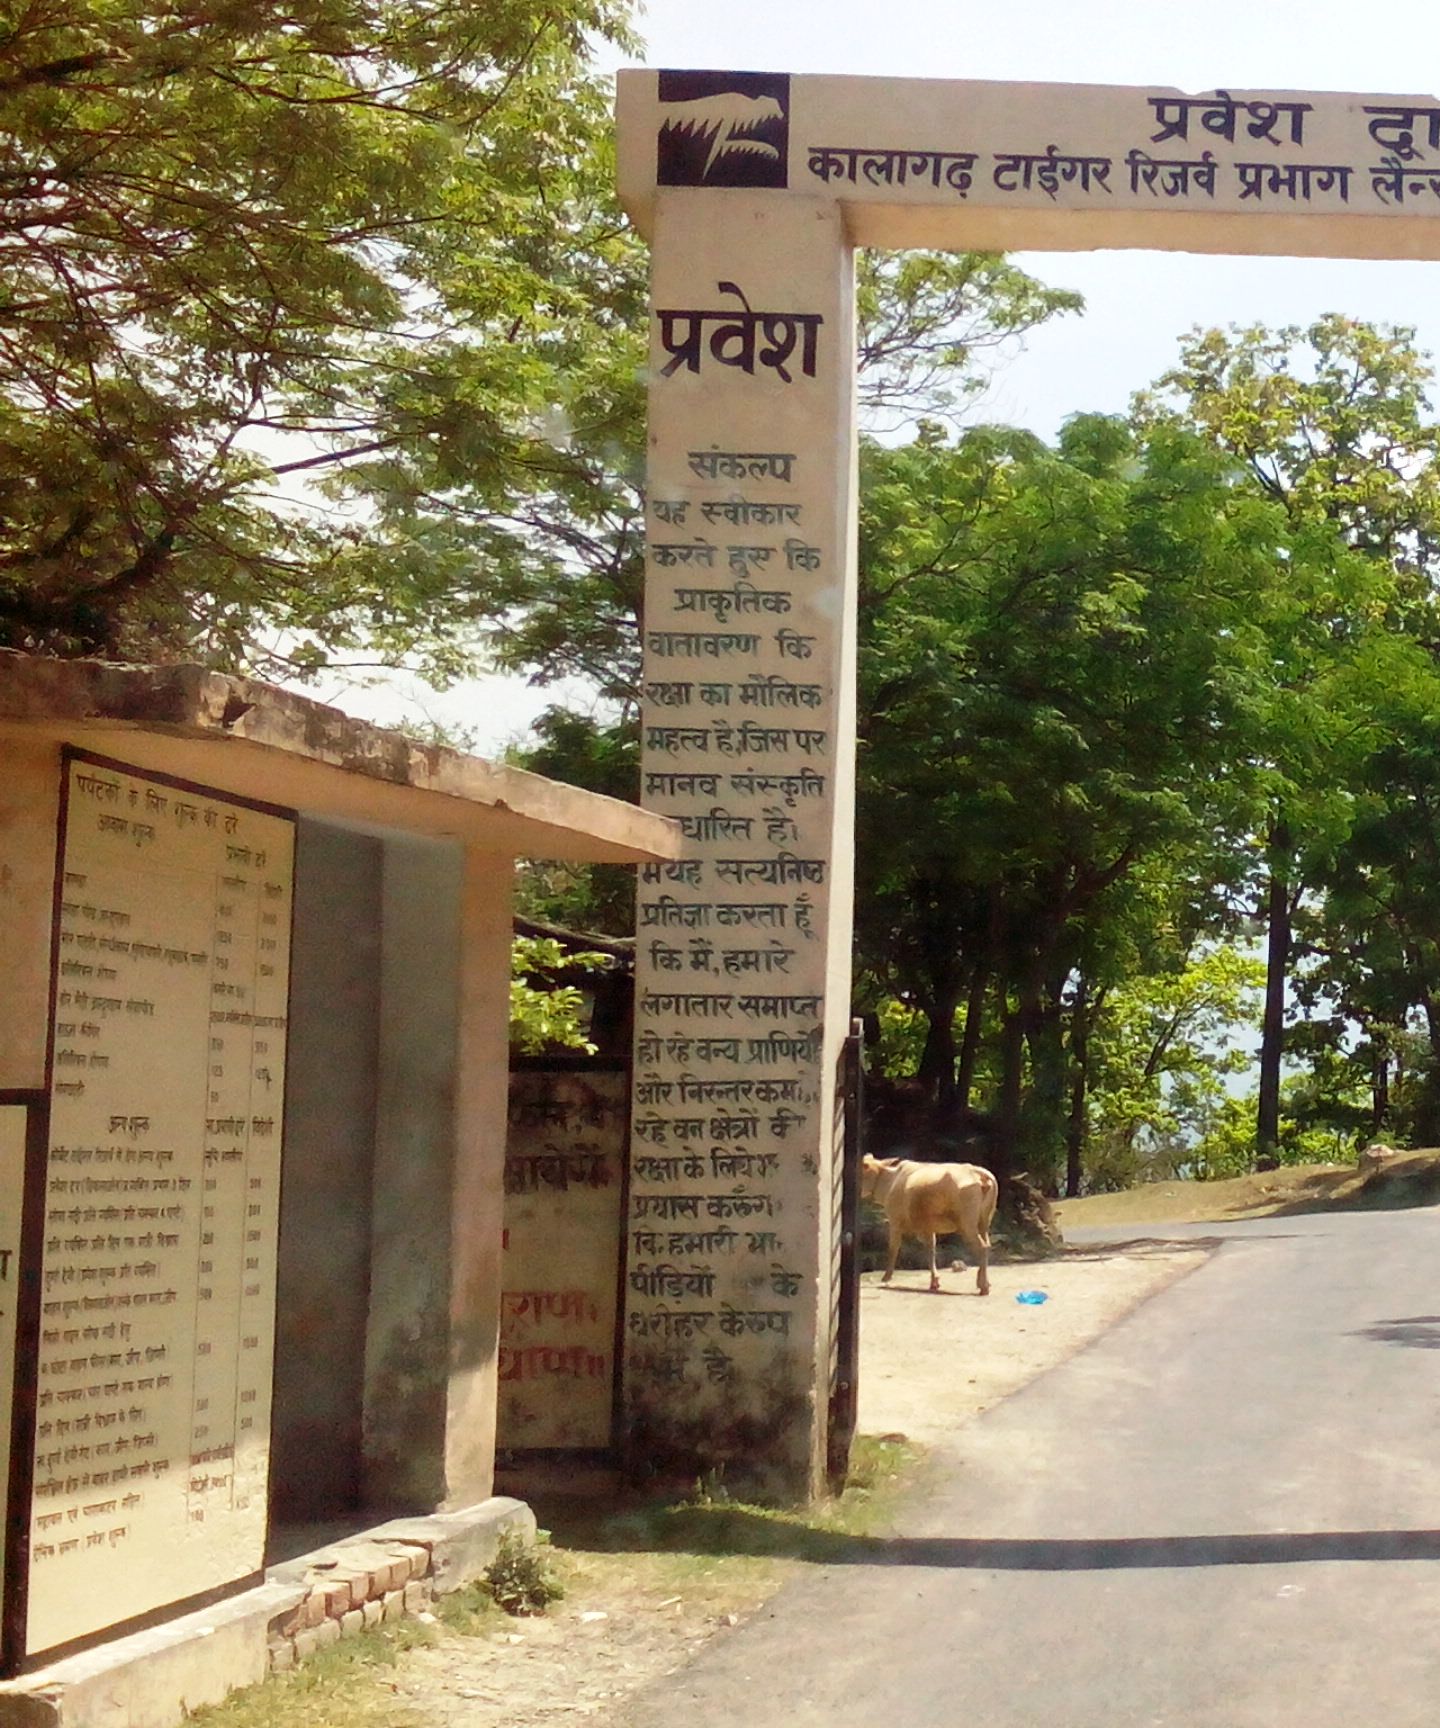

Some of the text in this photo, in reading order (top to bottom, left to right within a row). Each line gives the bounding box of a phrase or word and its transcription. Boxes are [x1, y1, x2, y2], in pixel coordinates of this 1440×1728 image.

[1148, 89, 1313, 147] प्रवेश
[994, 145, 1113, 202] टाईगर
[1125, 149, 1217, 198] रिजर्व
[1234, 162, 1354, 202] प्रभाग
[656, 281, 824, 383] प्रवेश
[688, 444, 797, 482] संकल्प
[652, 495, 802, 529] यह स्वीकार
[651, 537, 719, 567] करते
[783, 538, 821, 571] कि
[674, 581, 792, 623] प्राकृतिक
[648, 628, 817, 659] वातावरण कि
[646, 673, 822, 709] रक्षा का मौलिक
[793, 730, 827, 755] पर
[646, 766, 825, 807] मानव संस्कृति
[668, 808, 756, 842] धारित
[641, 895, 712, 929] प्रतिज्ञा
[716, 904, 788, 928] करता
[649, 941, 682, 972] कि
[722, 940, 796, 976] हमारे
[641, 994, 823, 1019] लगातार समाप्त
[638, 1030, 663, 1064] हो
[667, 1031, 695, 1068] रहे
[697, 1039, 742, 1064] वन्य
[636, 1072, 674, 1106] और
[634, 1111, 671, 1147] रहे
[674, 1118, 705, 1140] वन
[634, 1155, 684, 1183] रक्षा
[683, 1146, 705, 1179] के
